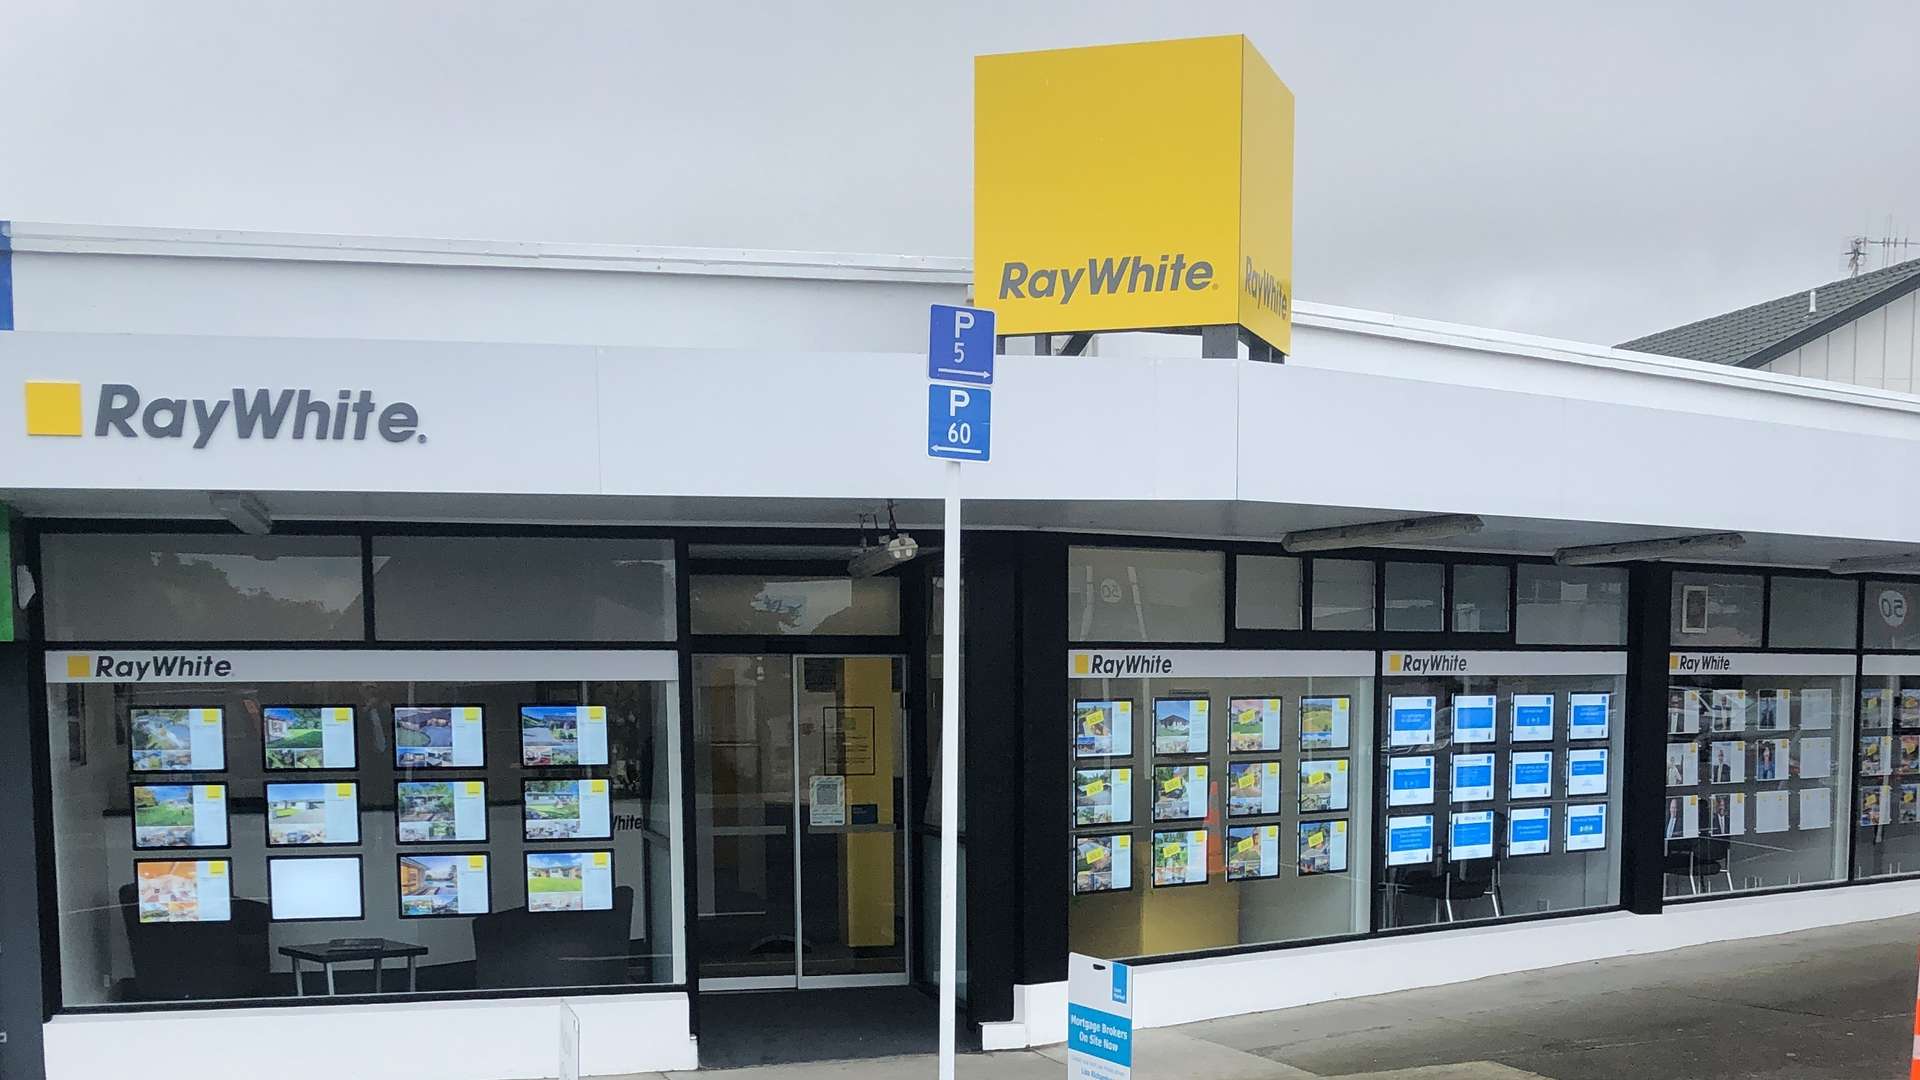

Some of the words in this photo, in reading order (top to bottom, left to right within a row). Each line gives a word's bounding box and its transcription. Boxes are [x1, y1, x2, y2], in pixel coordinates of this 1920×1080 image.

[954, 311, 975, 339] P
[954, 342, 965, 364] 5
[950, 389, 971, 417] P
[947, 422, 972, 444] 60
[1071, 1014, 1101, 1034] Mortgage
[1102, 1023, 1128, 1040] Brokers
[1079, 1031, 1089, 1044] On
[1089, 1034, 1103, 1048] Site
[1103, 1038, 1119, 1053] Now
